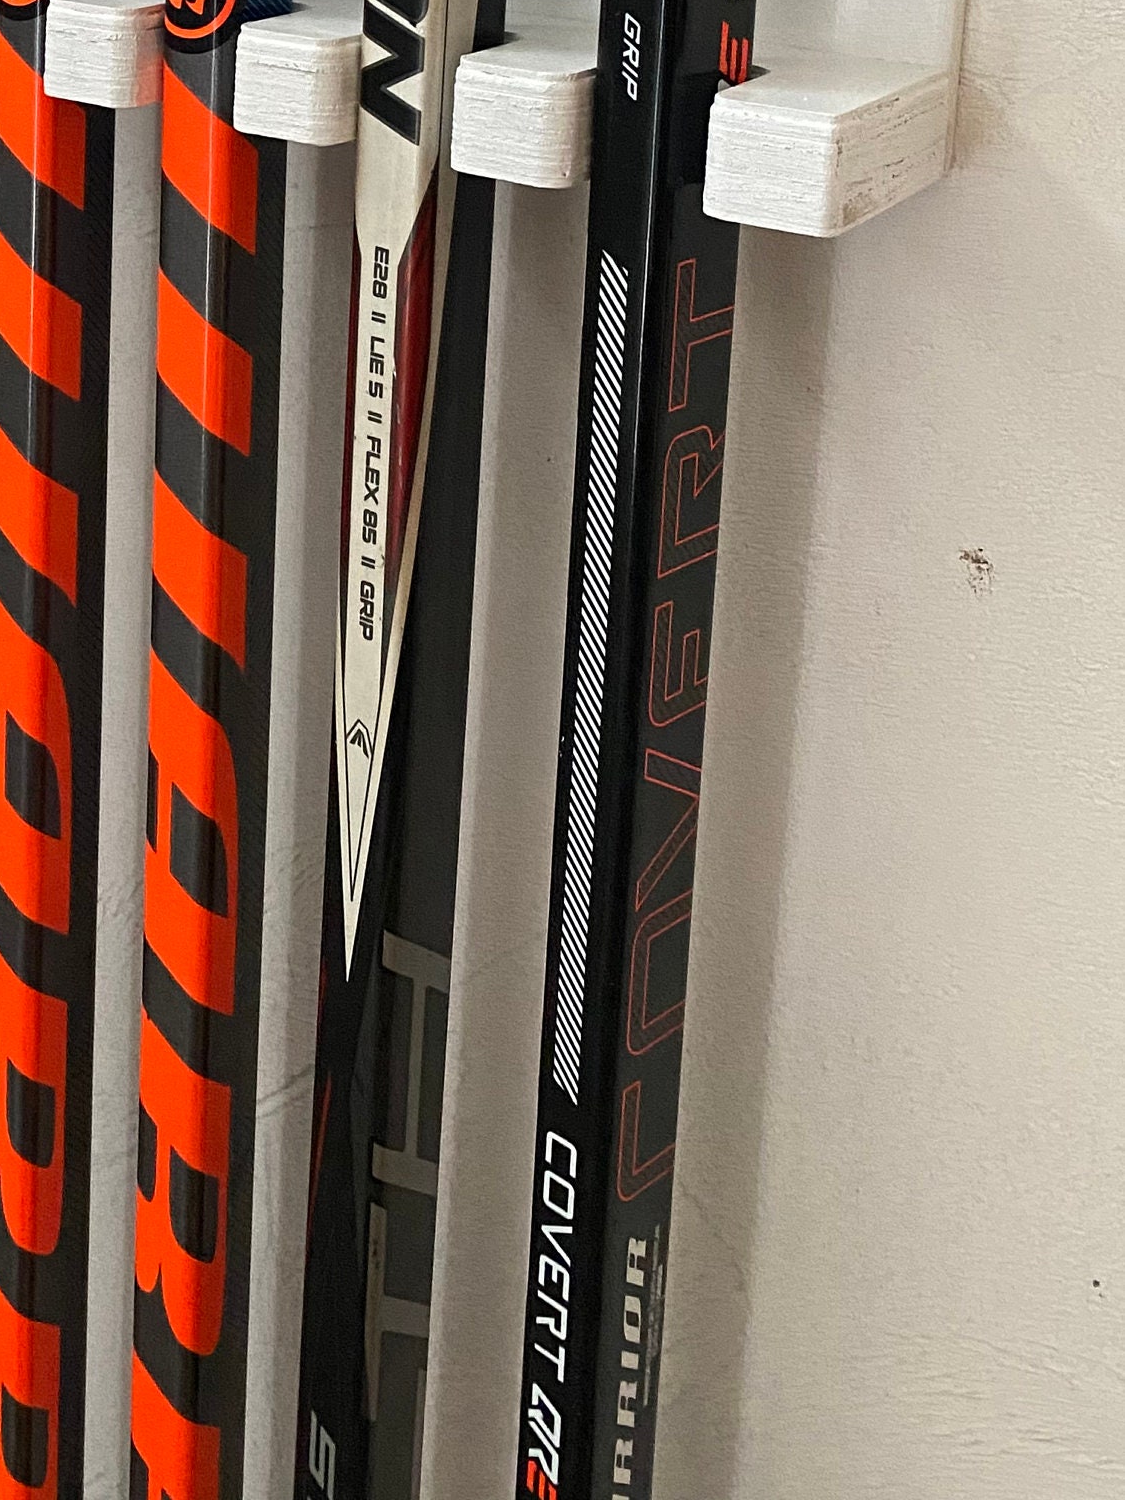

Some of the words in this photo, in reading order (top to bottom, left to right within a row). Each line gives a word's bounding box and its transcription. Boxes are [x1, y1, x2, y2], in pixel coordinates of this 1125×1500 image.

[621, 12, 642, 100] GRIP
[372, 246, 390, 299] E28
[369, 336, 386, 376] LIE
[368, 380, 384, 399] 5
[363, 435, 382, 504] FLEX
[362, 507, 379, 545] 85
[359, 580, 376, 641] GRIP
[617, 258, 735, 1202] COVERT
[535, 1130, 578, 1383] COVERT
[611, 1236, 647, 1500] RRIOR
